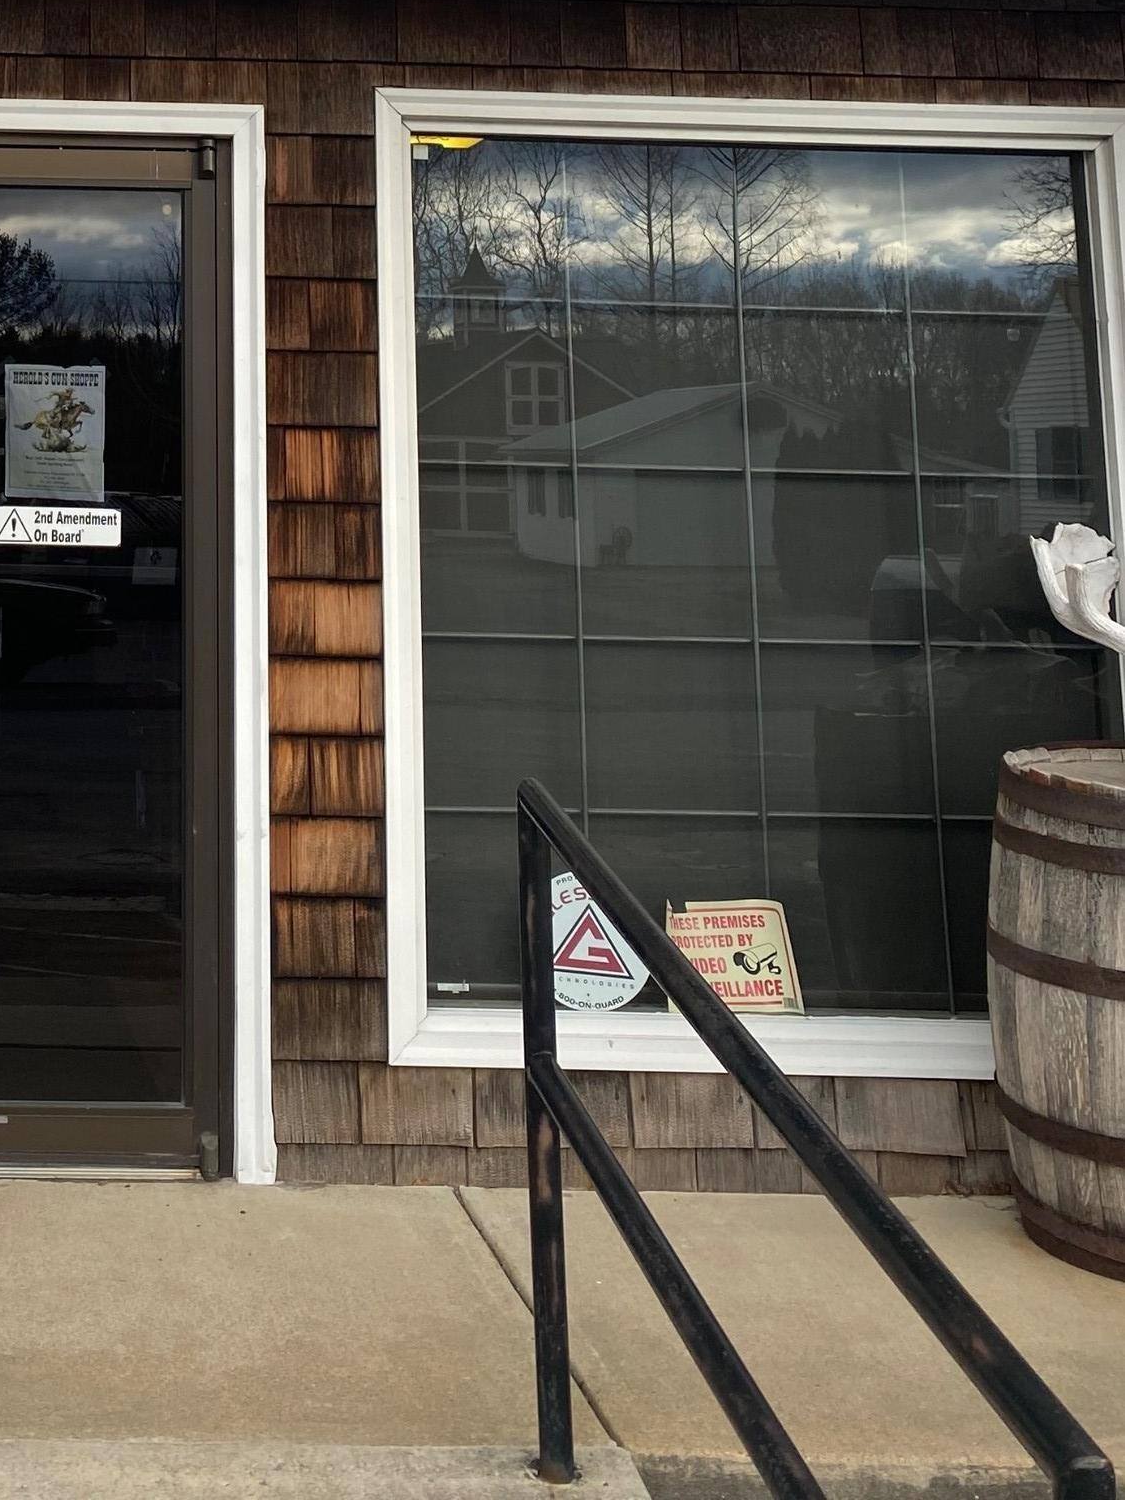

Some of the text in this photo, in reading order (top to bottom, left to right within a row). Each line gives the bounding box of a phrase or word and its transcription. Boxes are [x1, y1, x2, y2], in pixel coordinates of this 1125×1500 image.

[51, 372, 68, 386] GUN
[70, 373, 99, 387] SHOPPE
[35, 510, 117, 526] 2nd Amendment
[35, 529, 81, 543] On Board
[669, 914, 765, 930] THESE PREMISES
[738, 933, 753, 947] BY
